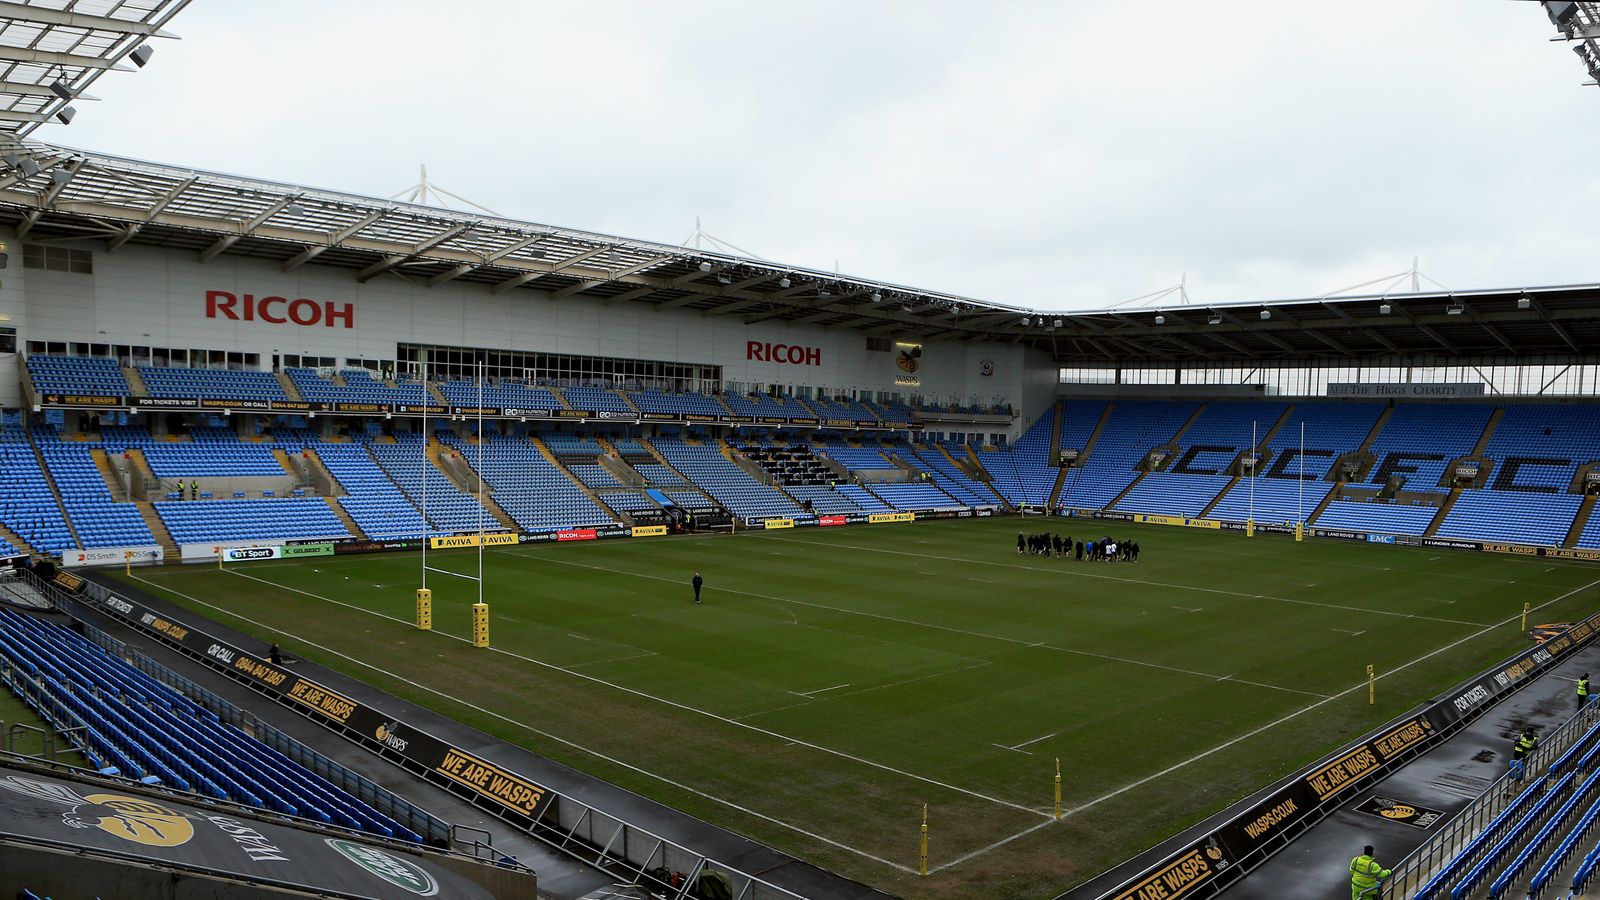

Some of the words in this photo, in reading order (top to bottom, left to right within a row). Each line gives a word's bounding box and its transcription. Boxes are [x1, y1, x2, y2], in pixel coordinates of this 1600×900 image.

[206, 290, 354, 329] RICOH
[747, 340, 821, 367] RICOH
[896, 374, 918, 384] WASPS
[1376, 385, 1406, 395] HIGGS
[1413, 386, 1457, 396] CHARITY
[446, 538, 472, 546] AVIVA
[1370, 534, 1391, 542] EMC
[235, 551, 248, 559] BT
[249, 549, 270, 559] Sport
[208, 644, 219, 656] OR
[216, 648, 236, 663] CALL
[235, 657, 256, 672] 0844
[291, 682, 306, 697] WE
[304, 687, 323, 705] ARE
[319, 694, 355, 718] WASPS
[1453, 695, 1470, 712] FOR
[1464, 684, 1488, 706] TICKETS
[387, 731, 408, 750] WASPS
[1376, 743, 1392, 760] WE
[1387, 734, 1407, 753] ARE
[1401, 724, 1425, 748] WASPS
[441, 752, 466, 774] WE
[460, 762, 493, 786] ARE
[488, 772, 541, 811] WASPS
[1309, 777, 1332, 796] WE
[1328, 765, 1349, 786] ARE
[1343, 749, 1377, 778] WASPS
[1244, 797, 1299, 840] WASPS.CO.UK
[1162, 853, 1209, 892] WASPS
